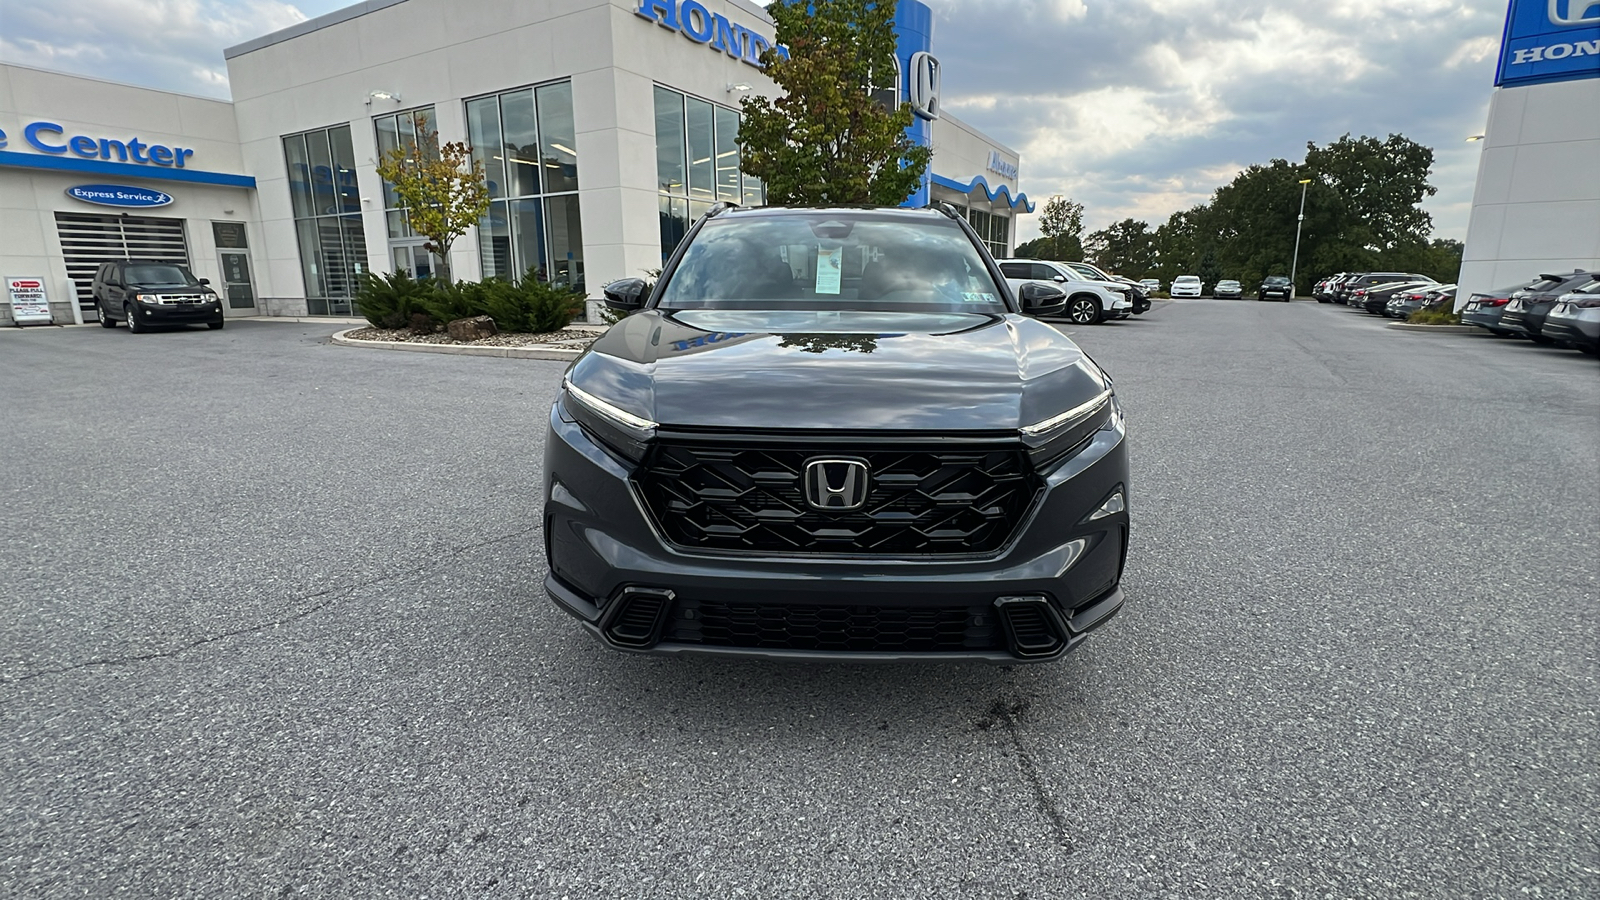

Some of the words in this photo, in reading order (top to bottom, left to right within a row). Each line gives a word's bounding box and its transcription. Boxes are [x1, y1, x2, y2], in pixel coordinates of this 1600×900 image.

[24, 121, 194, 168] Center
[73, 188, 115, 199] Express
[116, 191, 153, 201] Service
